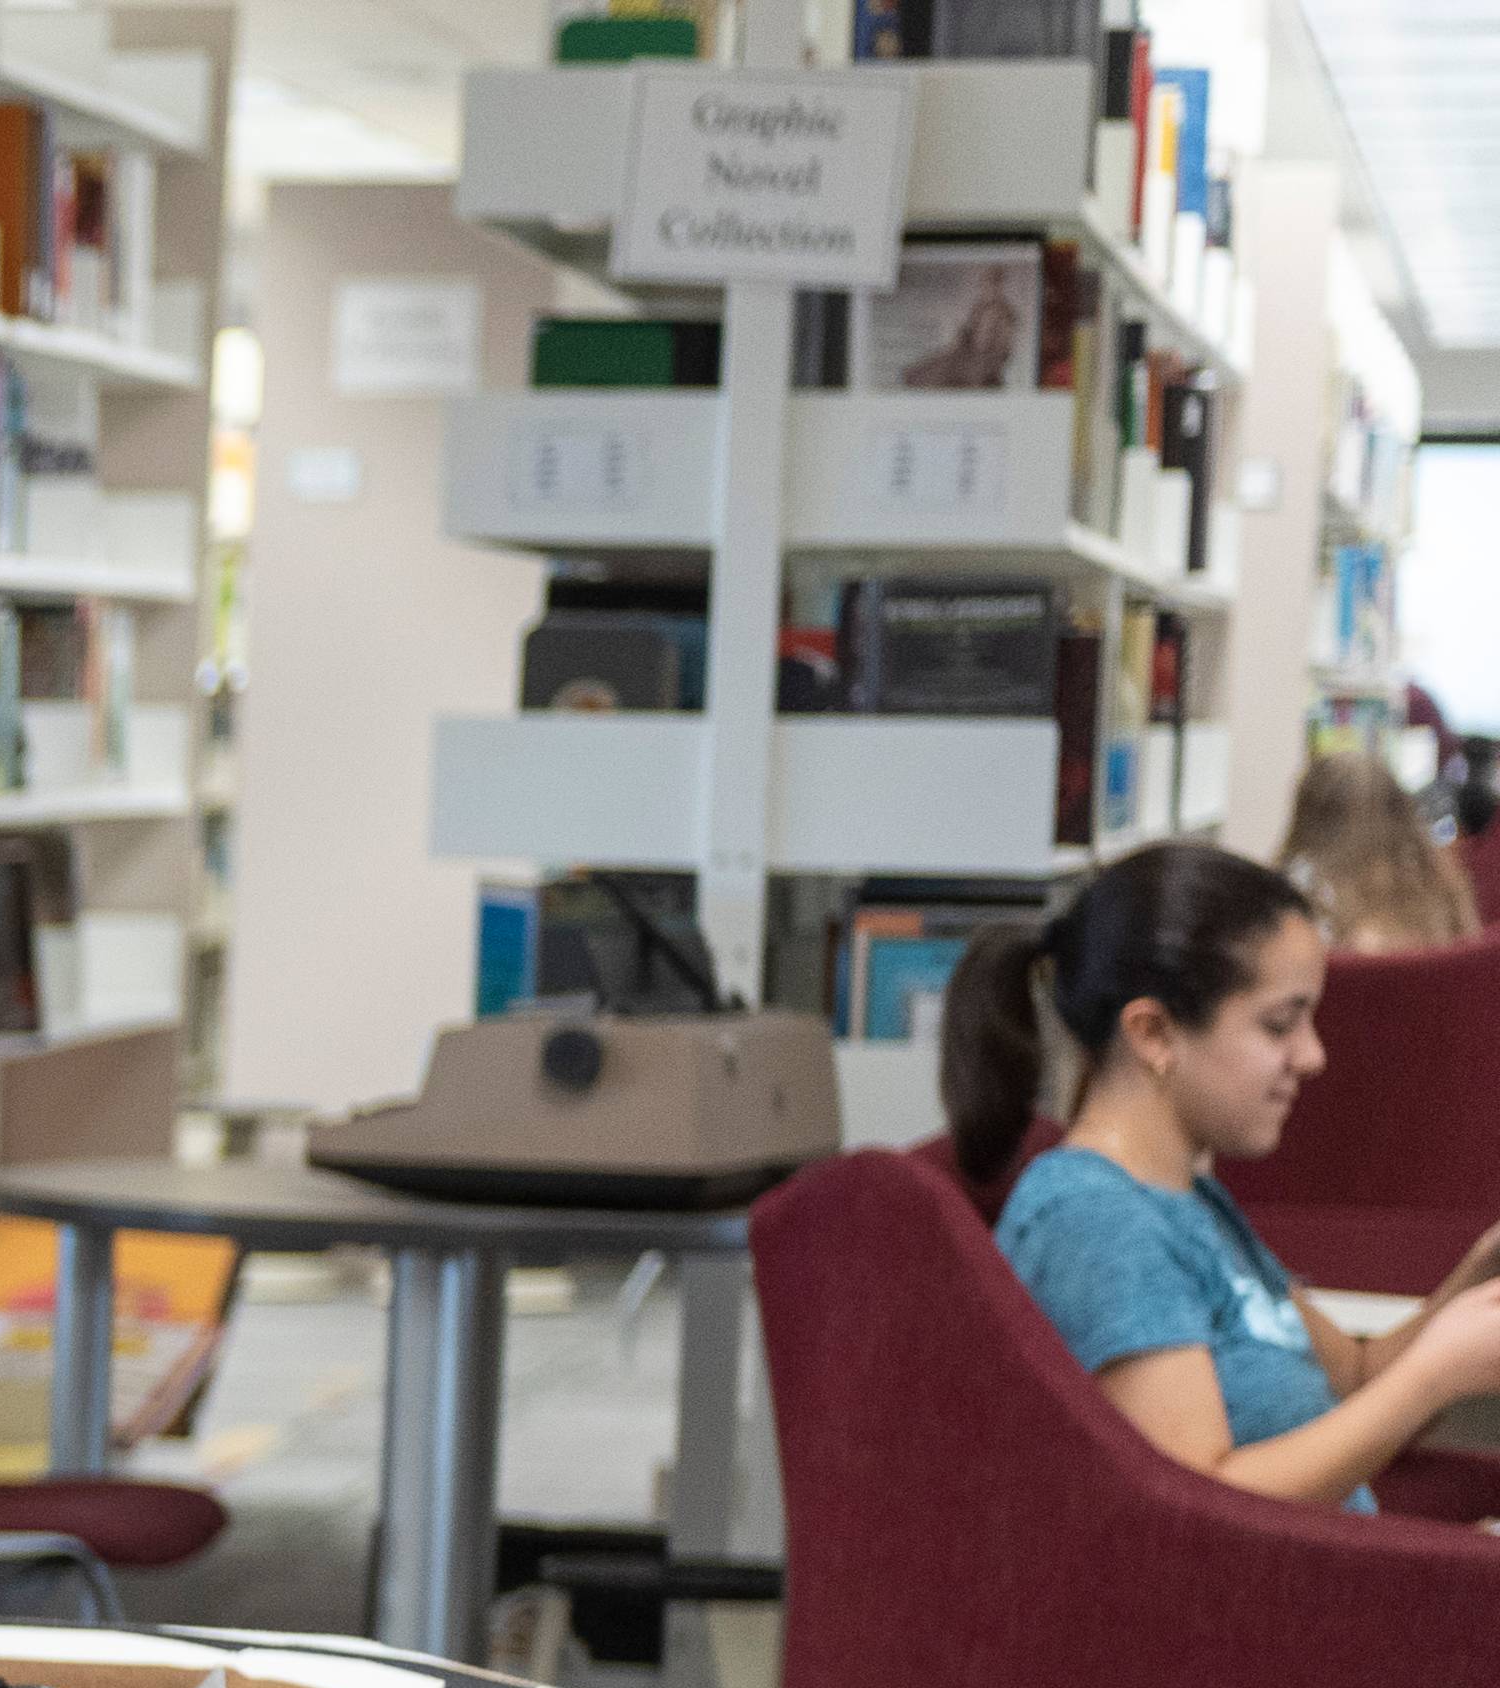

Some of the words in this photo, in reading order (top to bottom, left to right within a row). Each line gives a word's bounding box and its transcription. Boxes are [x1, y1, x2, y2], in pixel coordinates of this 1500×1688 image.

[692, 92, 843, 149] Graphic
[706, 154, 823, 194] Novel
[657, 206, 854, 253] Collection
